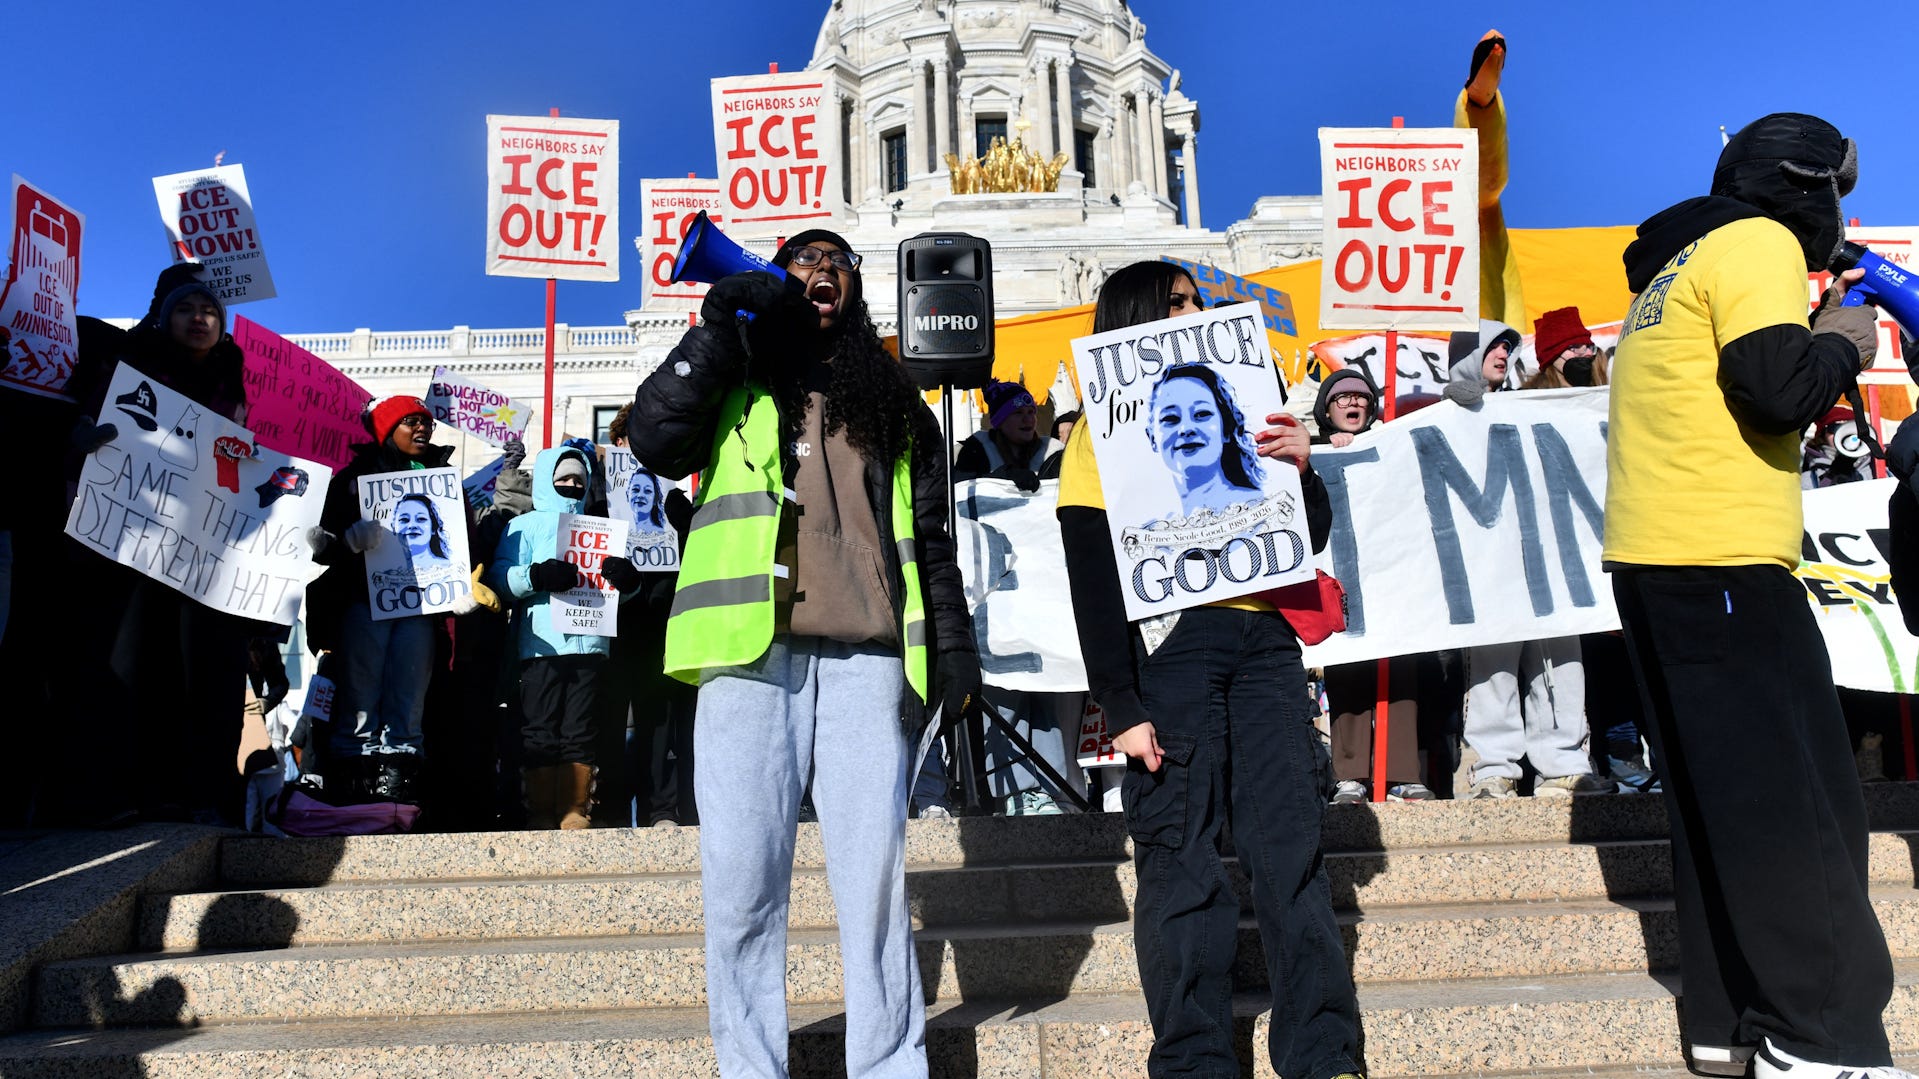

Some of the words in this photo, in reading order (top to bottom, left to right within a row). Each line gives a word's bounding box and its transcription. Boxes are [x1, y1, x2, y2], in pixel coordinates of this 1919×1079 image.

[724, 98, 795, 114] NEIGHBORS
[799, 96, 821, 107] SAY
[501, 138, 577, 155] NEIGHBORS
[581, 144, 605, 156] SAY
[726, 114, 818, 160] ICE
[1336, 157, 1426, 172] NEIGHBORS
[1432, 158, 1461, 171] SAY
[501, 154, 598, 207] ICE
[729, 165, 827, 210] OUT!
[178, 185, 229, 212] ICE
[652, 198, 710, 208] NEIGHBORS
[1338, 177, 1454, 237] ICE
[179, 208, 239, 235] OUT
[499, 203, 606, 257] OUT!
[173, 228, 256, 260] NOW!
[212, 266, 232, 277] WE
[236, 274, 252, 285] US
[1334, 239, 1465, 301] OUT!
[1878, 263, 1908, 284] PYLE
[218, 286, 247, 299] AFE!
[1231, 273, 1285, 310] ICE
[34, 292, 52, 316] OUT
[54, 301, 64, 320] OF
[10, 310, 72, 347] MINNESOTA
[1088, 315, 1265, 404] JUSTICE
[459, 399, 484, 414] NOT
[1103, 388, 1144, 439] for
[88, 445, 189, 519] SAME
[364, 473, 458, 510] JUSTICE
[613, 472, 629, 491] for
[371, 503, 392, 521] for
[76, 484, 225, 596] DIFFRENT
[226, 567, 300, 615] HAT
[569, 530, 609, 550] ICE
[564, 550, 612, 570] OUT
[1132, 529, 1304, 603] GOOD
[375, 580, 469, 612] GOOD
[578, 599, 592, 607] WE
[565, 608, 591, 617] KEEP
[592, 610, 604, 618] US
[572, 619, 598, 628] SAFE!
